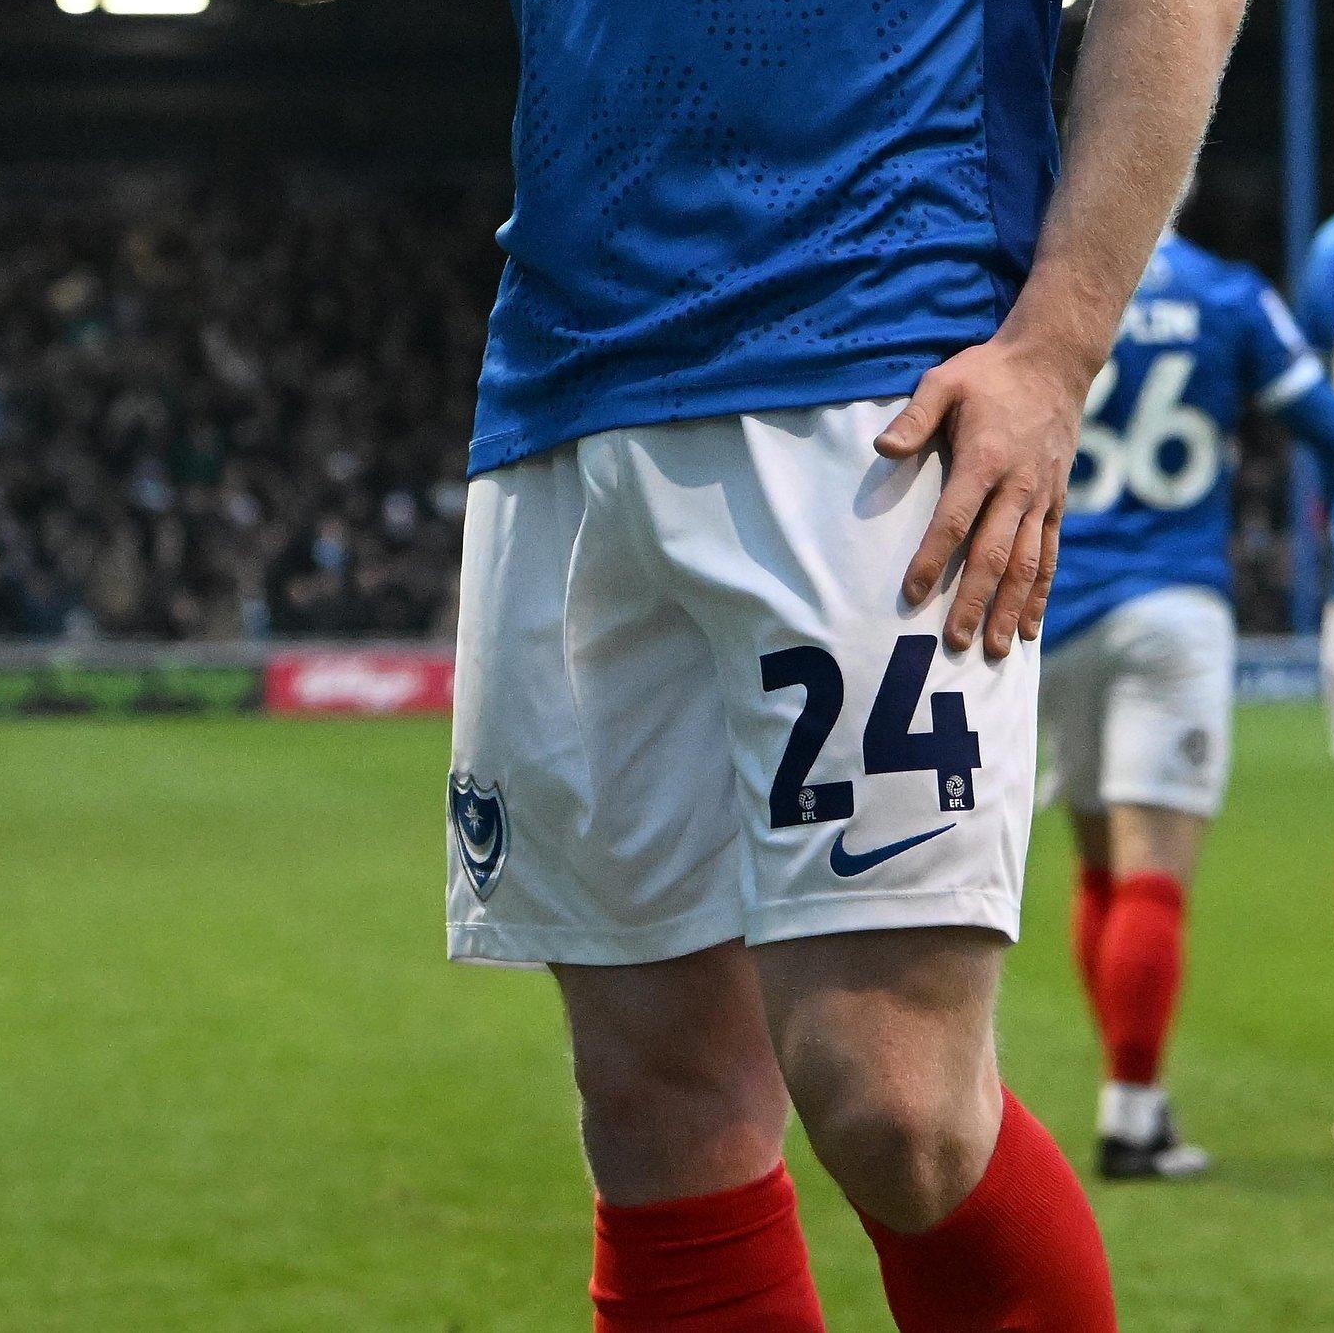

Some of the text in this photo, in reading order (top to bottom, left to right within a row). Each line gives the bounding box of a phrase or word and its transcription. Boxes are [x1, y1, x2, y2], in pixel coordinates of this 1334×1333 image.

[759, 634, 983, 829] 24
[948, 798, 965, 808] EFL
[801, 811, 817, 821] EFL
